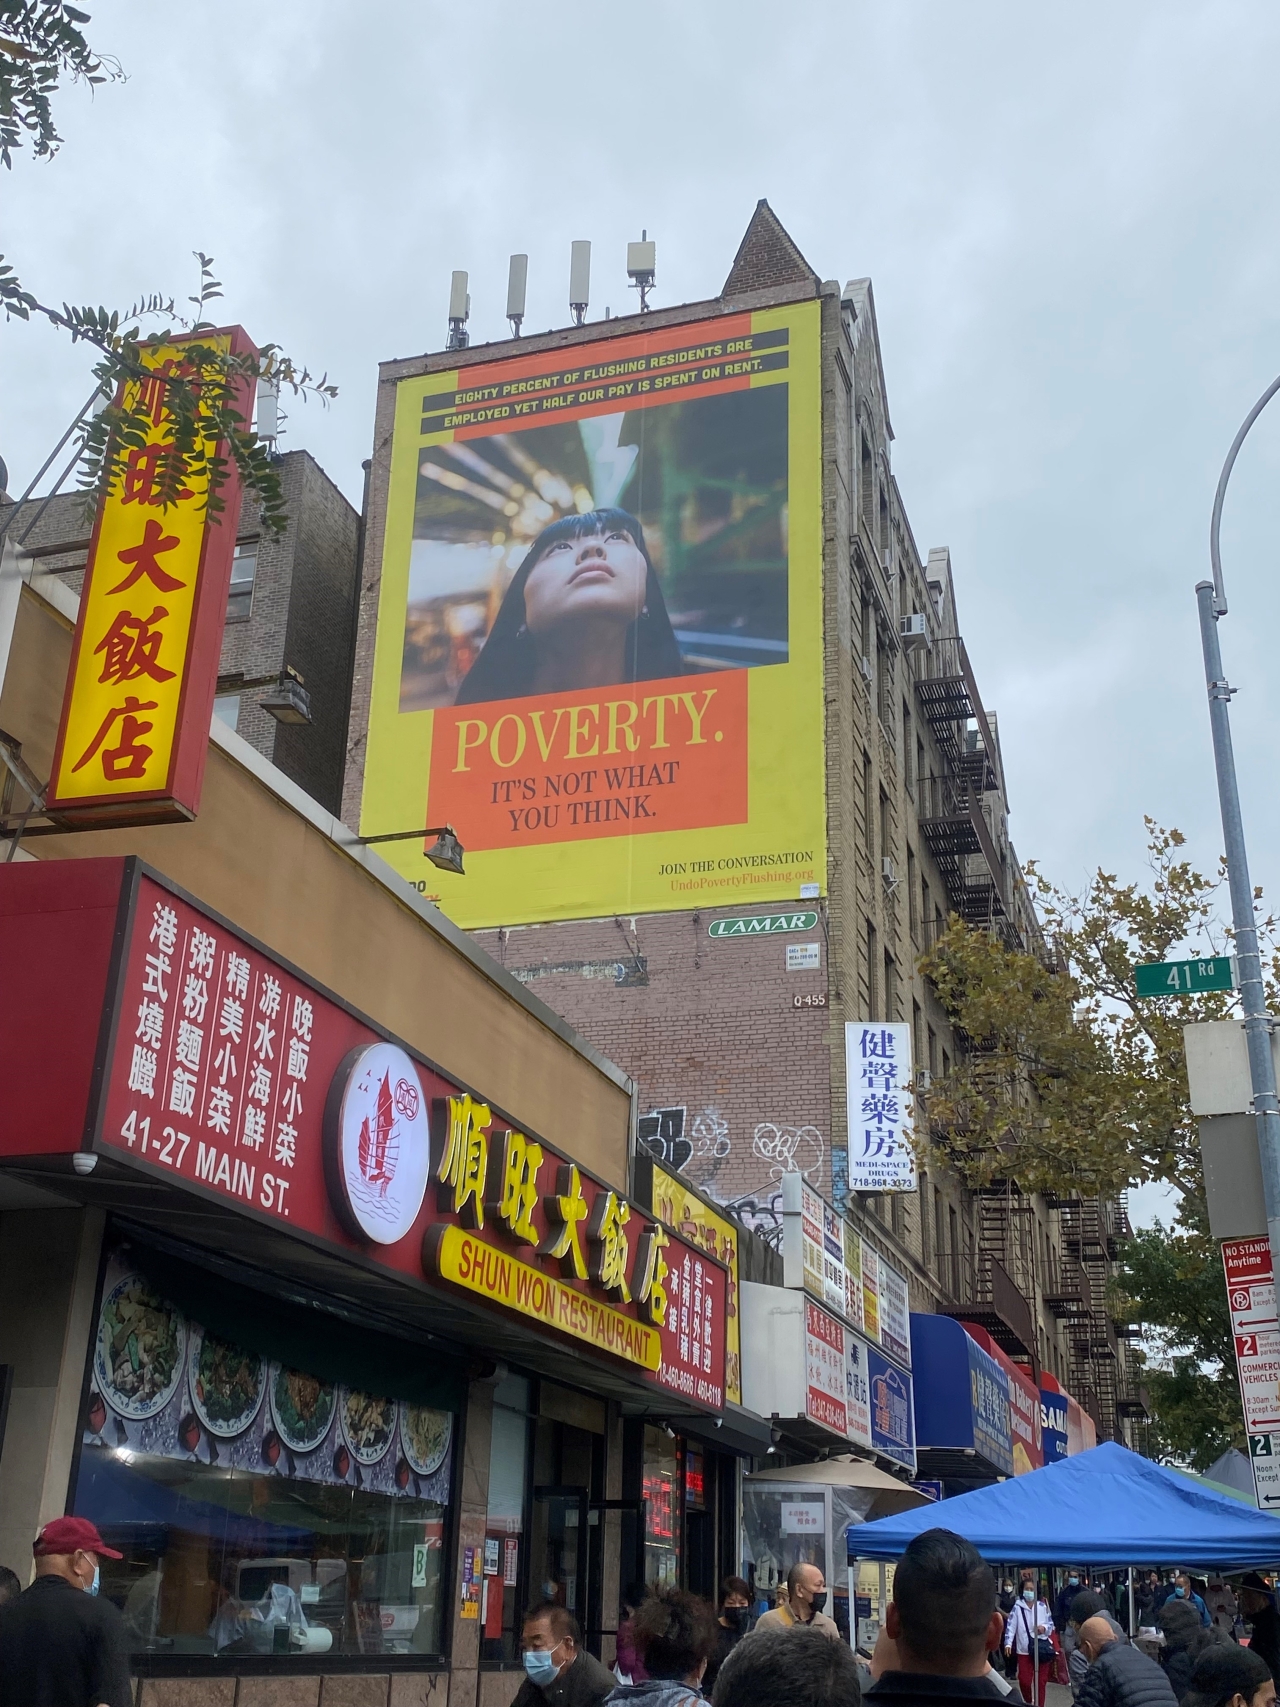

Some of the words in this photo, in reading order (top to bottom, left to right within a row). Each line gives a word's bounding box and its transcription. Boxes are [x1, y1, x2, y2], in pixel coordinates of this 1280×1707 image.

[455, 388, 499, 405] EIGHTY
[503, 375, 559, 397] PERCENT
[564, 372, 580, 385] OF
[584, 360, 646, 381] FLUSHING
[650, 346, 722, 369] RESIDENTS
[725, 338, 753, 354] ARE
[444, 406, 510, 428] EMPLOYED
[514, 400, 538, 416] YET
[543, 394, 575, 410] HALF
[578, 388, 604, 404] OUR
[608, 382, 634, 398] PAY
[638, 380, 652, 392] IS
[654, 372, 698, 390] SPENT
[702, 366, 720, 380] ON
[724, 359, 763, 376] RENT.
[452, 689, 724, 772] POVERTY.
[491, 777, 536, 804] IT'S
[544, 770, 597, 798] NOT
[604, 762, 680, 790] WHAT
[508, 805, 558, 832] YOU
[567, 795, 657, 826] THINK.
[659, 863, 686, 876] JOIN
[690, 860, 714, 874] THE
[718, 851, 814, 870] CONVERSATION
[670, 869, 814, 892] UndoPovertyFlushing.org
[716, 914, 806, 935] LAMAR
[1166, 965, 1192, 990] 41
[1198, 961, 1214, 976] Rd
[128, 902, 178, 1100] 港式燒臘
[794, 994, 825, 1006] Q-455
[169, 926, 216, 1119] 粥粉麵飯
[207, 952, 250, 1136] 精美小菜
[242, 972, 282, 1152] 游水海鮮
[274, 994, 314, 1168] 晚飯小菜
[858, 1029, 900, 1158] 健聲藥房
[120, 1110, 190, 1168] 41-27
[195, 1141, 256, 1200] MAIN
[260, 1173, 290, 1216] ST.
[437, 1093, 670, 1328] 順旺大飯店
[824, 1206, 840, 1241] FedEx
[1226, 1247, 1237, 1257] NO
[1228, 1256, 1262, 1268] Anytime
[458, 1240, 510, 1298] SHUN
[517, 1269, 558, 1314] WON
[560, 1290, 651, 1362] RESTAURANT
[692, 1260, 703, 1368] 堂食外賣
[1254, 1299, 1271, 1307] Except
[704, 1276, 714, 1374] 一律歡迎
[1242, 1336, 1253, 1355] 2
[1244, 1373, 1279, 1384] VEHICLES
[1247, 1397, 1269, 1405] 8:30am
[1248, 1406, 1268, 1414] Except
[1254, 1436, 1266, 1455] 2
[1257, 1474, 1278, 1482] Except
[417, 1550, 424, 1576] B
